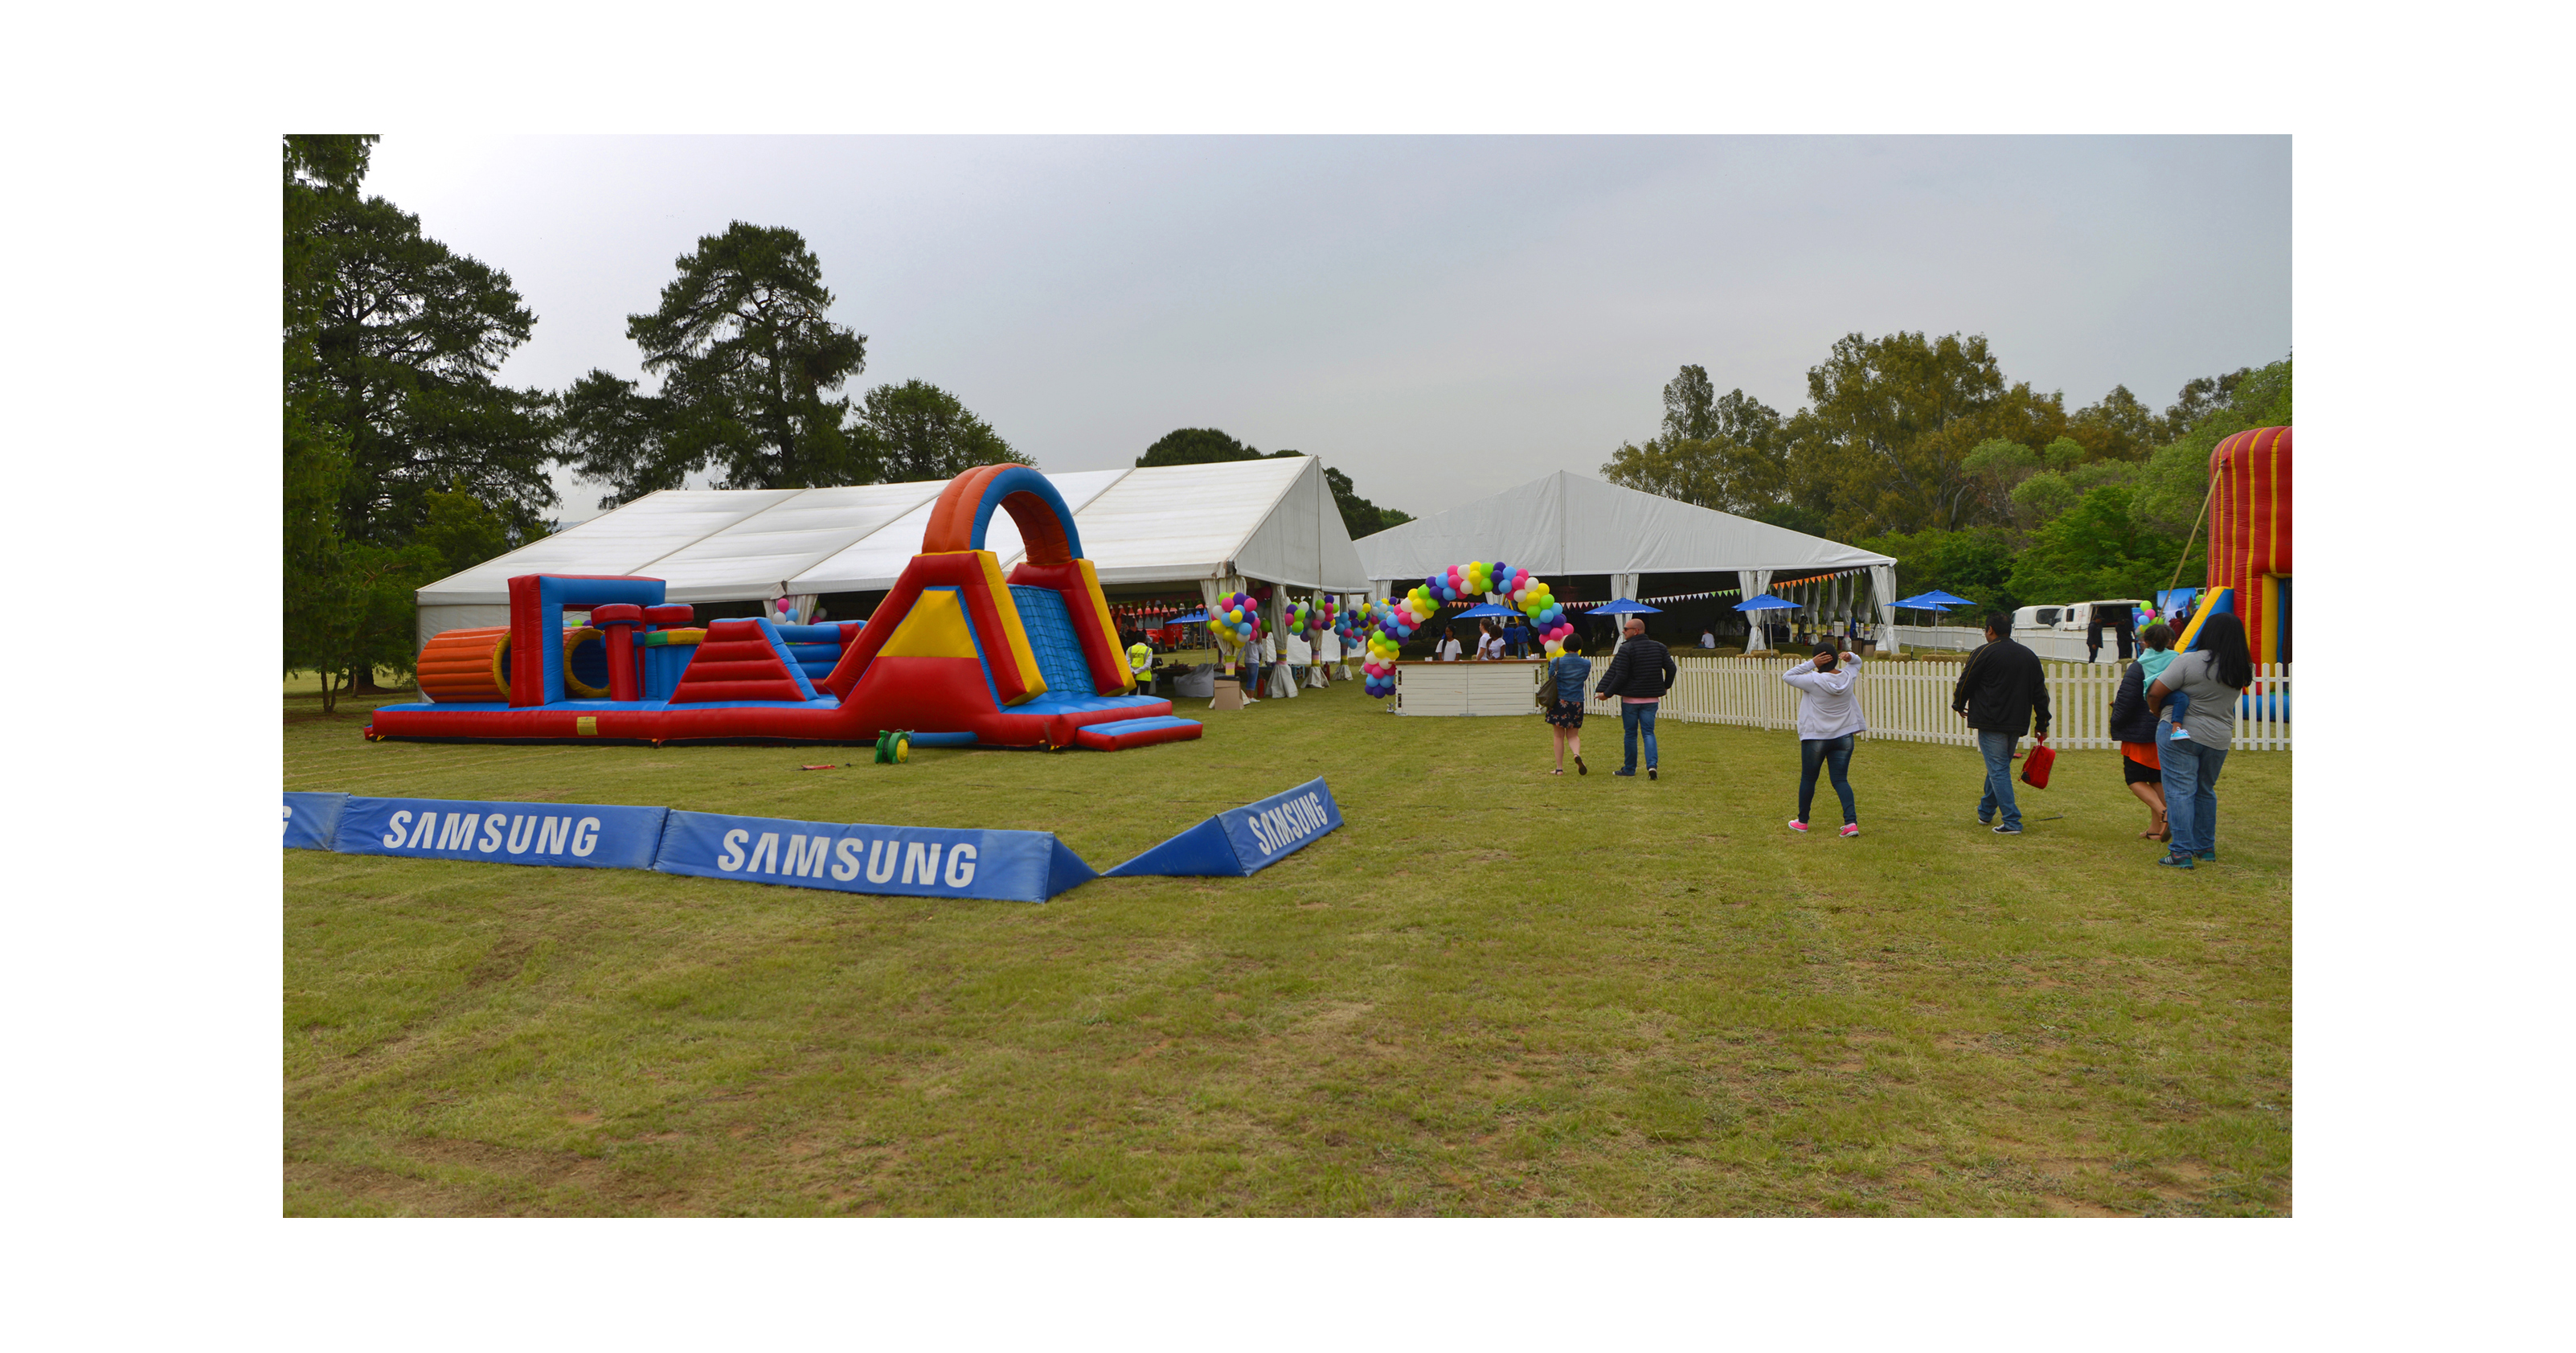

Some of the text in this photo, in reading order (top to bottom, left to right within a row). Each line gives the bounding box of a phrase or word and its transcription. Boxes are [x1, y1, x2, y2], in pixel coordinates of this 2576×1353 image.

[383, 810, 600, 857] SAMSUNG
[1248, 792, 1328, 855] SAMSUNG
[718, 829, 977, 888] SAMSUNG
